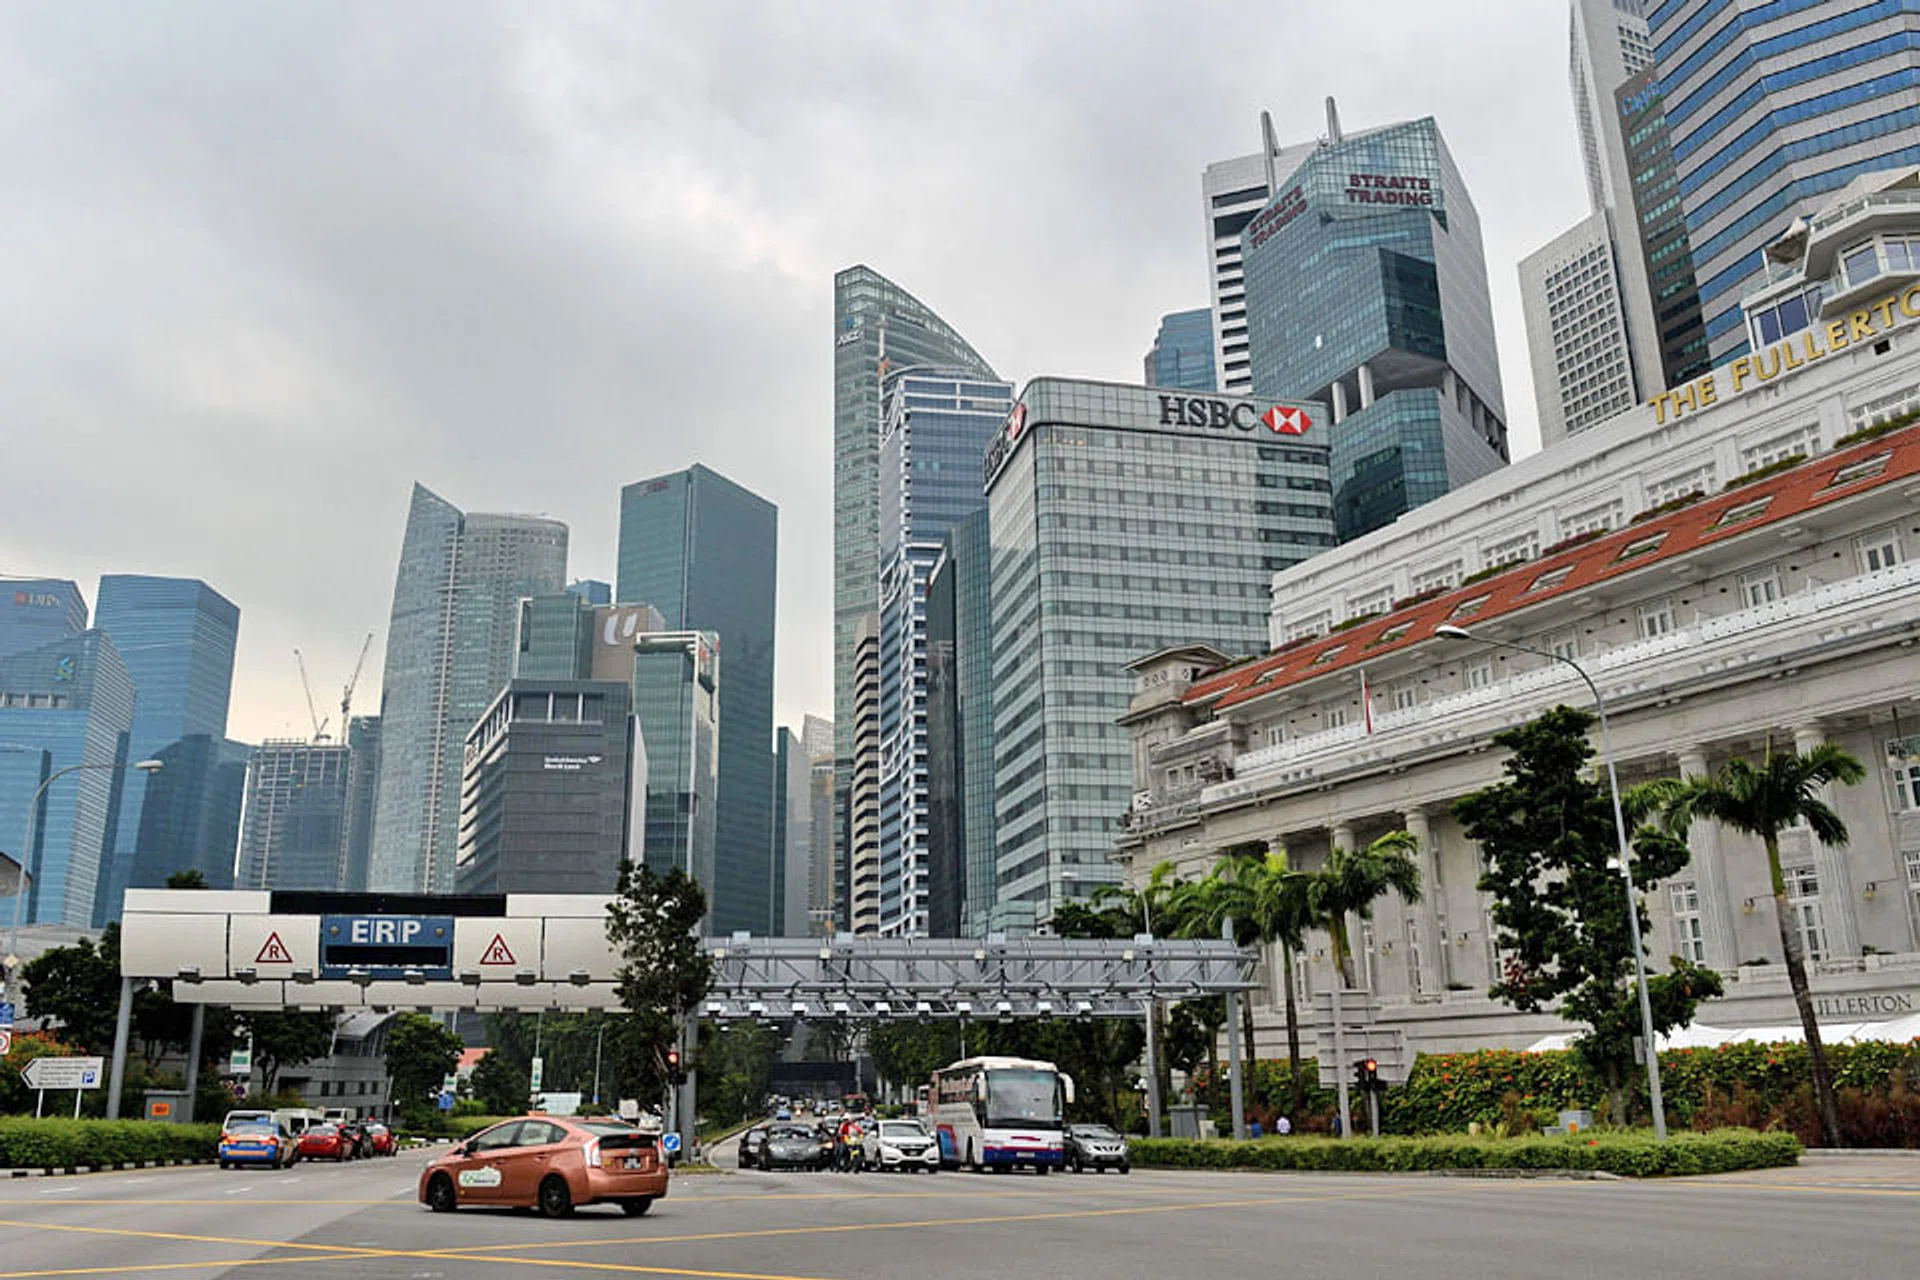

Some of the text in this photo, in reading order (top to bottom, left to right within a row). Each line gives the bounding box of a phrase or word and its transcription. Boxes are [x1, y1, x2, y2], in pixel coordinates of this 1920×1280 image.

[1349, 174, 1430, 190] STRAITS
[1346, 188, 1433, 205] TRADING
[1648, 375, 1718, 425] THE
[1157, 395, 1257, 432] HSBC
[269, 945, 280, 959] R
[493, 947, 504, 961] R
